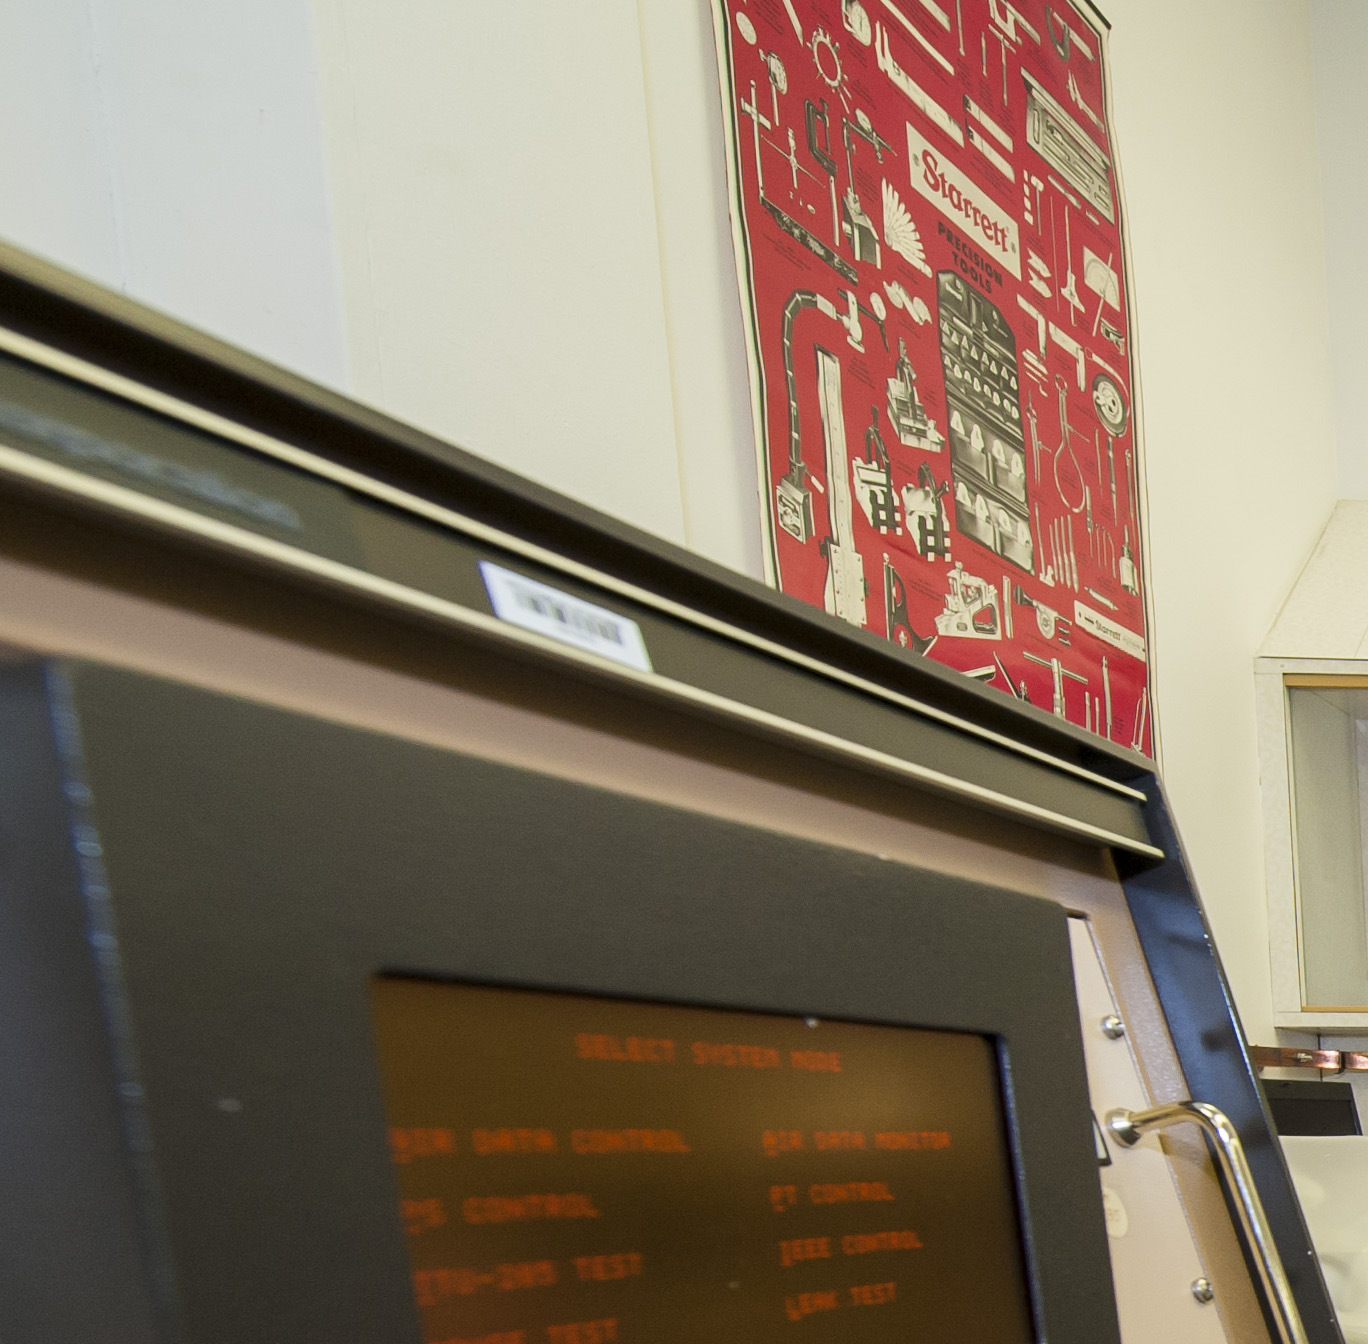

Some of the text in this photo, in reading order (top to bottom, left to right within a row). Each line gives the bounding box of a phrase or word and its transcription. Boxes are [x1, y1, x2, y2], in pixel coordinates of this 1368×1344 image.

[922, 149, 1008, 252] Starrett
[938, 221, 1003, 287] PRECISION
[952, 250, 993, 294] TOOLS
[574, 1034, 842, 1073] SELECT SYSTEM MODE
[472, 1128, 557, 1154] DATA
[570, 1128, 692, 1154] CONTROL
[814, 1131, 867, 1150] DATA
[809, 1182, 895, 1204] CONTROL
[463, 1194, 599, 1224] CONTROL
[841, 1230, 924, 1255] CONTROL
[573, 1252, 642, 1281] TEST
[850, 1282, 897, 1305] TEST
